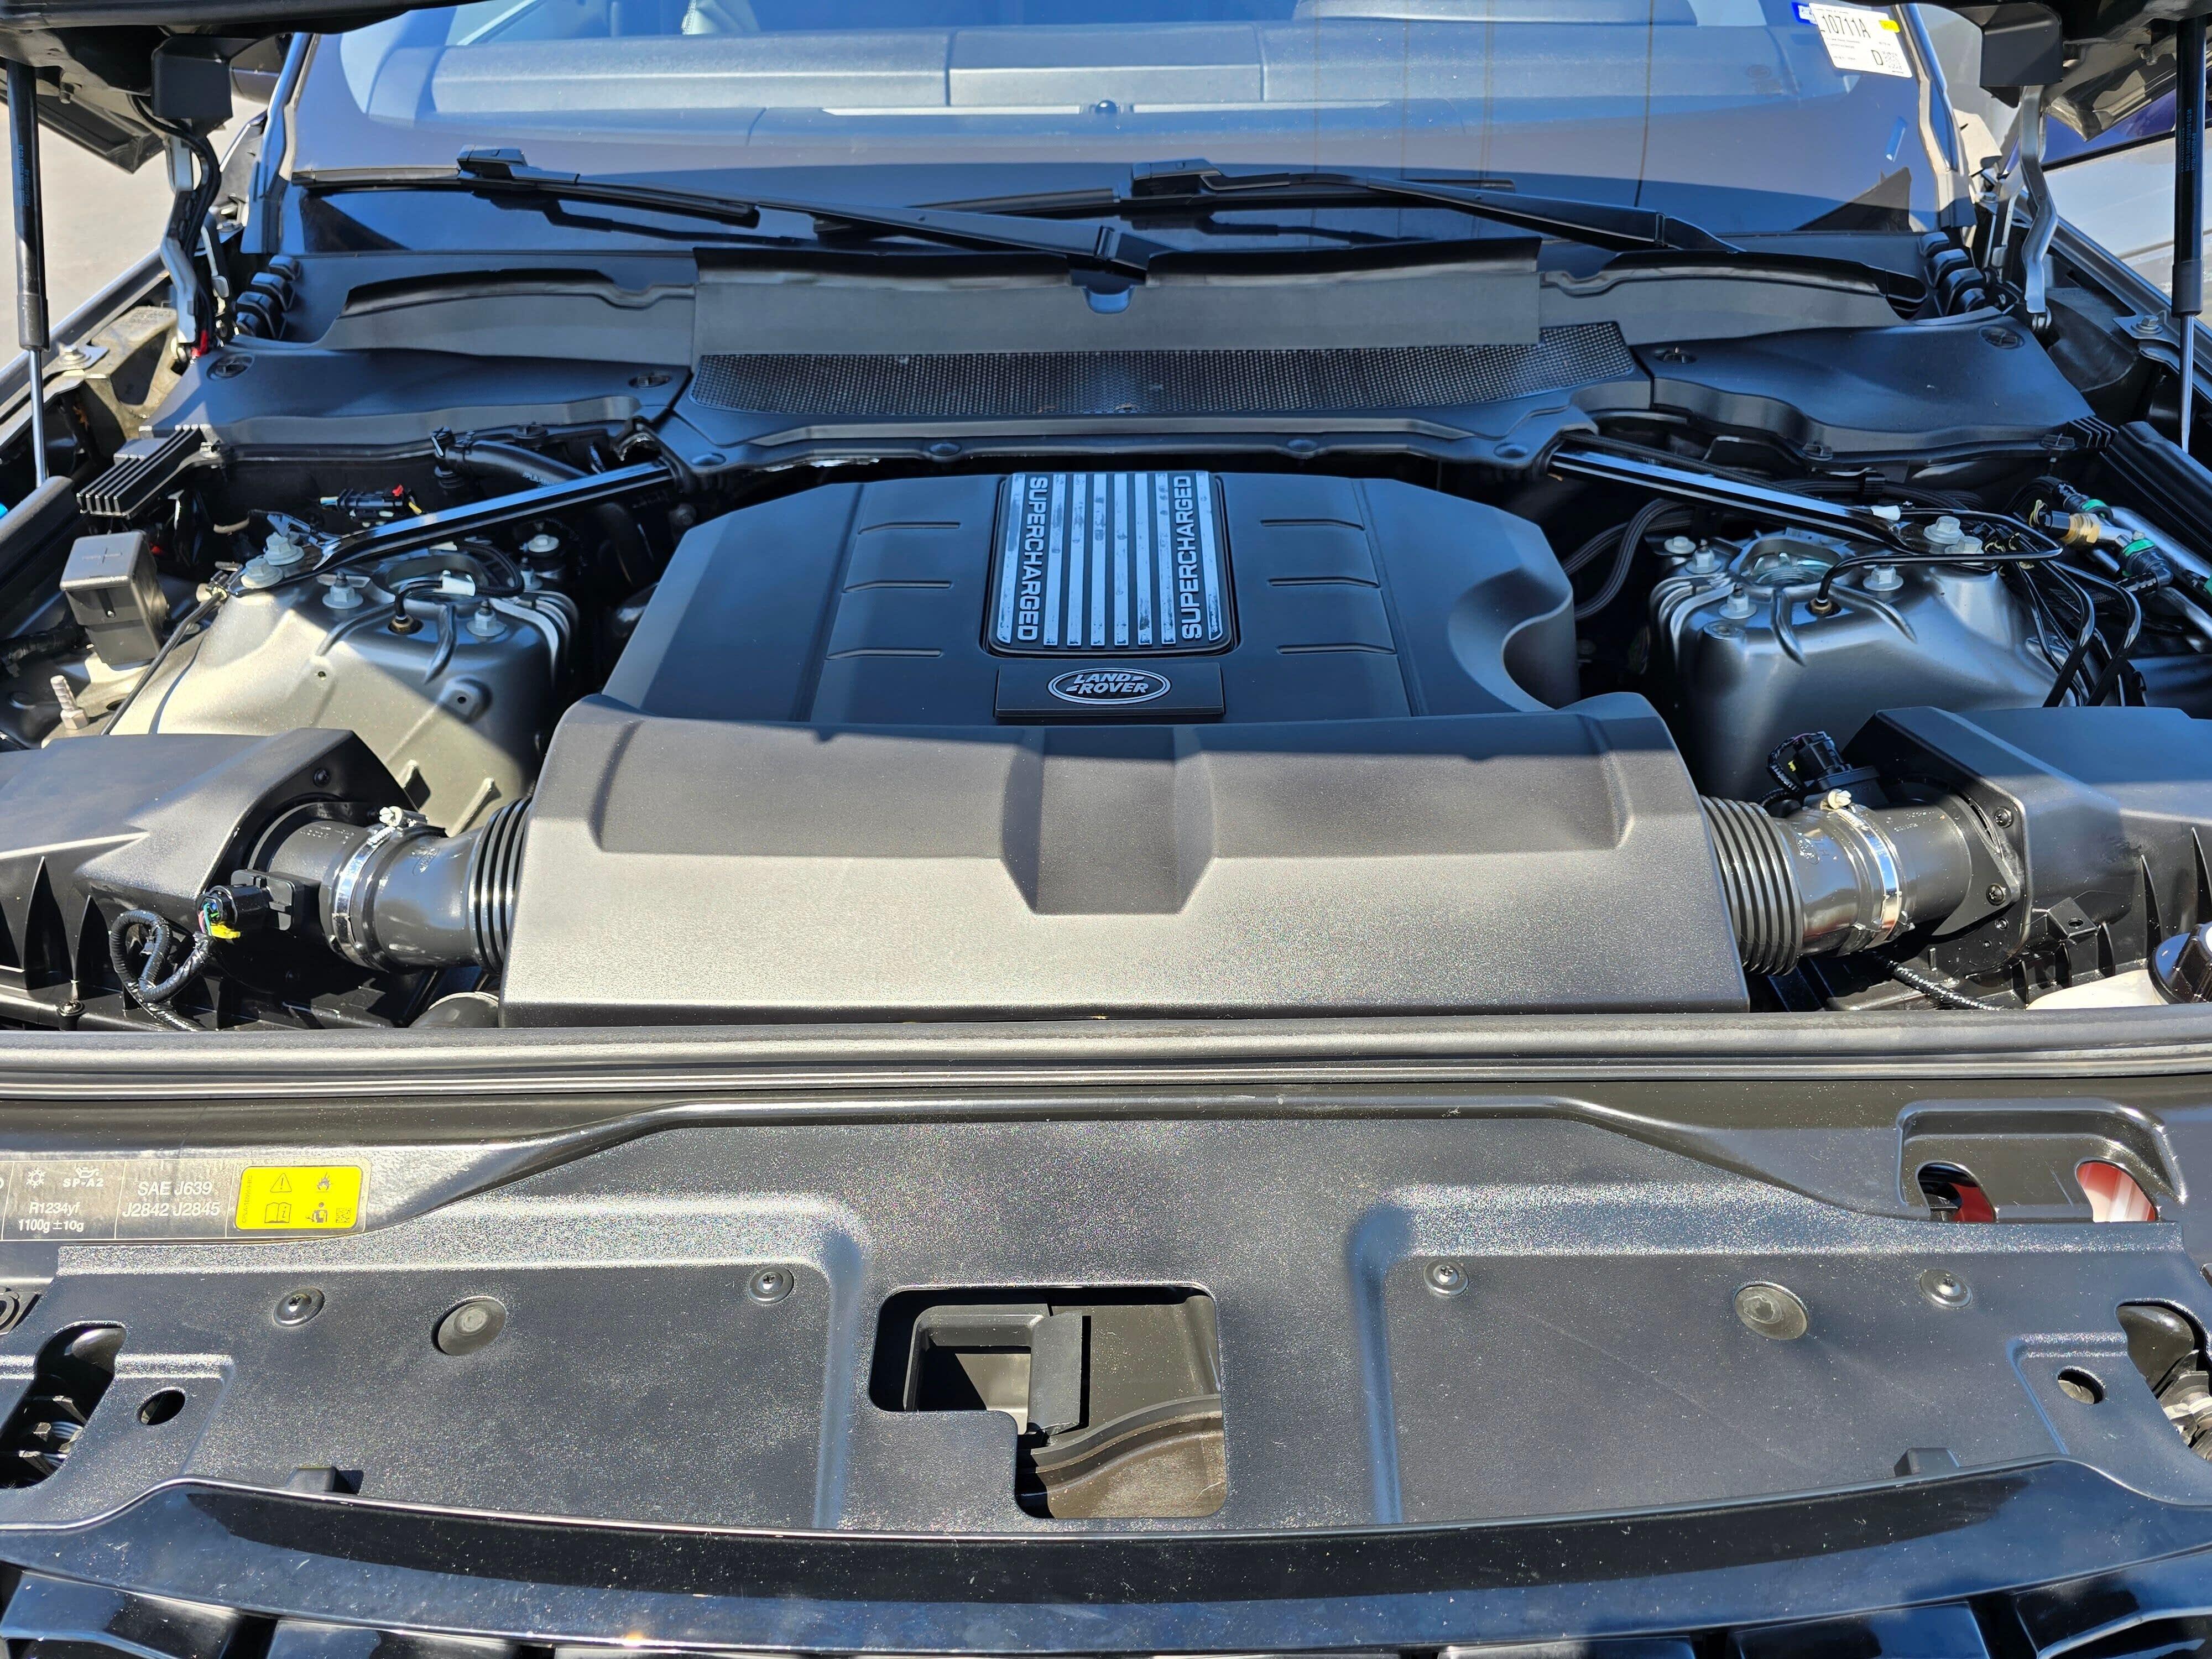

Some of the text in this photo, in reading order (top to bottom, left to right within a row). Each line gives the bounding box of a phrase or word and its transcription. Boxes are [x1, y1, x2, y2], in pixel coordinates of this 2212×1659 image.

[1871, 50, 1884, 65] D
[1017, 476, 1048, 641] SUPERCHARGED
[1173, 475, 1202, 639] SUPERCHARGED
[1074, 673, 1131, 684] LAND
[1077, 682, 1149, 694] ROVER
[62, 1178, 104, 1188] SP-A2
[138, 1181, 213, 1196] SAE J639
[28, 1201, 81, 1217] R1234yf
[122, 1201, 221, 1217] J2842 J2845
[18, 1219, 50, 1234] 1100g
